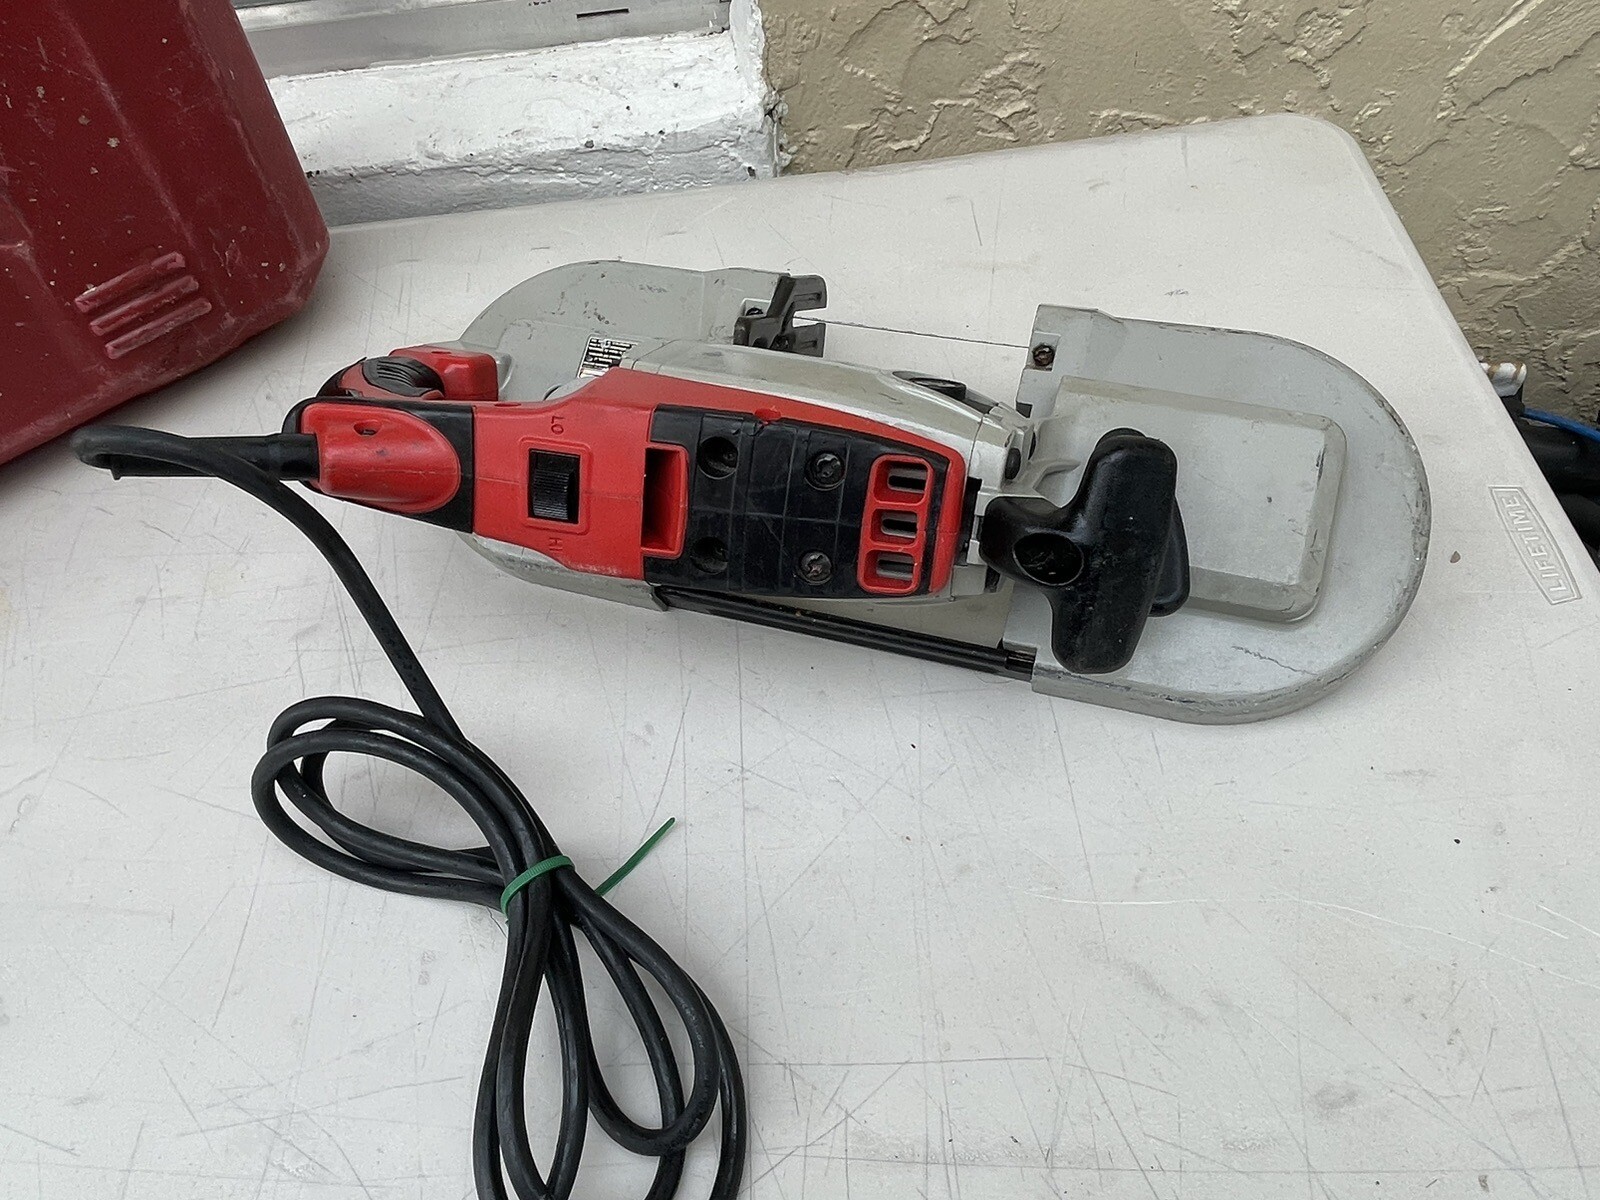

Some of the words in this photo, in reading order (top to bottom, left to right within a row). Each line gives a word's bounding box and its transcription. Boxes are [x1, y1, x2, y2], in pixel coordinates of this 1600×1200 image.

[551, 415, 565, 435] LO
[549, 537, 563, 551] HI
[1501, 496, 1567, 591] LIFETIME
